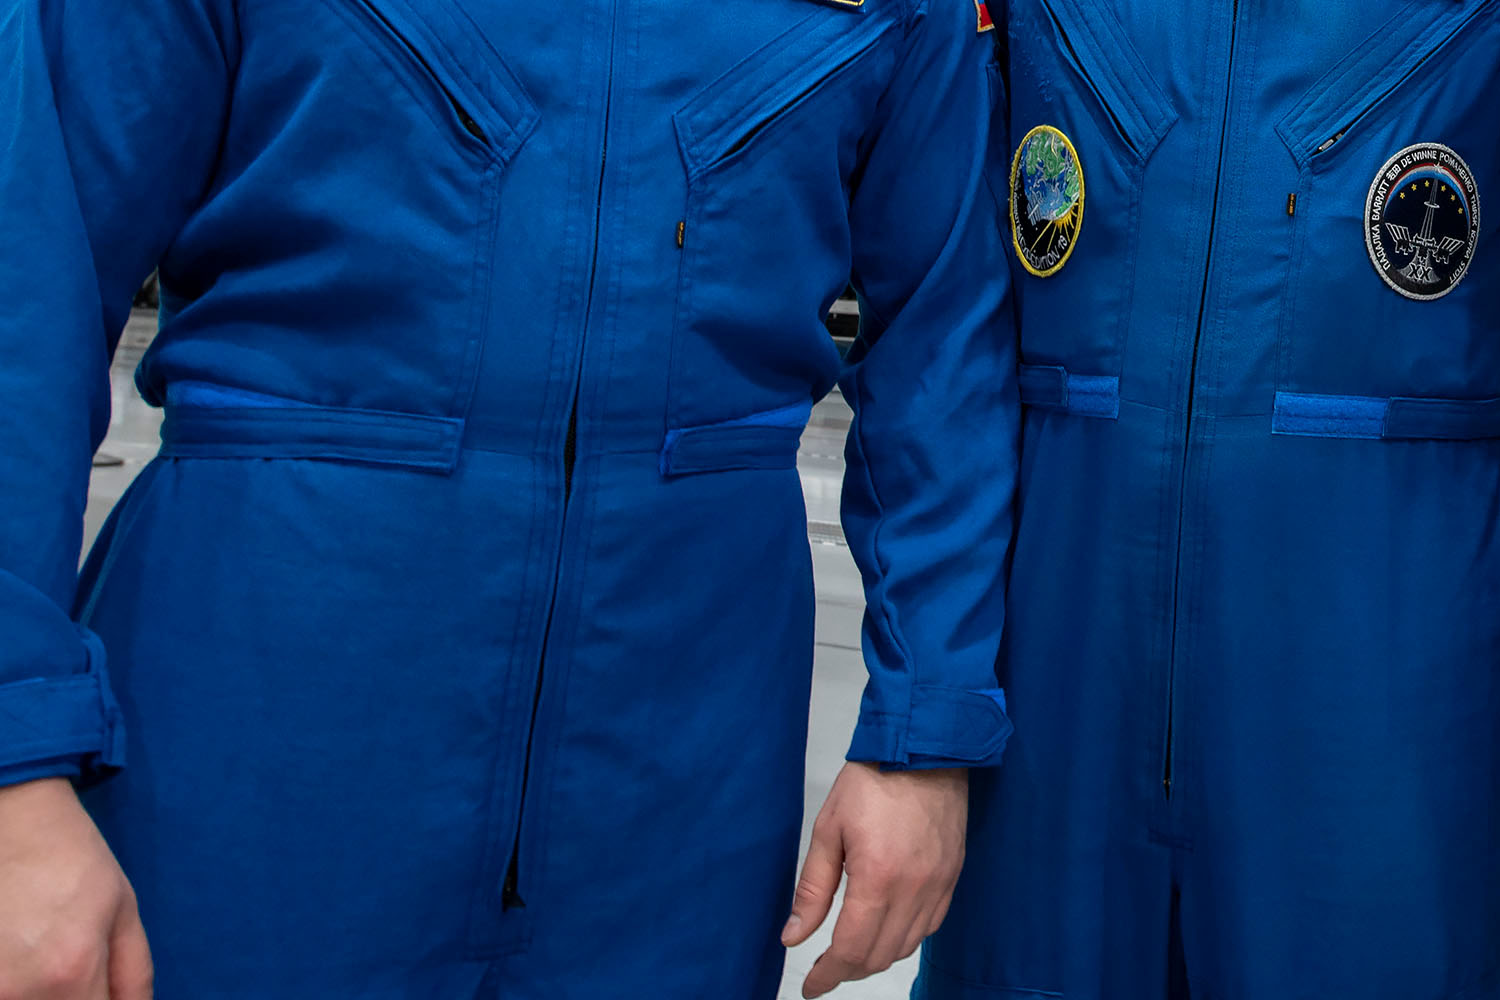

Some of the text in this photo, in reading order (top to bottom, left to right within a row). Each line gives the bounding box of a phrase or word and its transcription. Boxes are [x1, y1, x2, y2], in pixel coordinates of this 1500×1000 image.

[1401, 150, 1437, 168] DE WINNE
[1372, 179, 1390, 221] BARRATT
